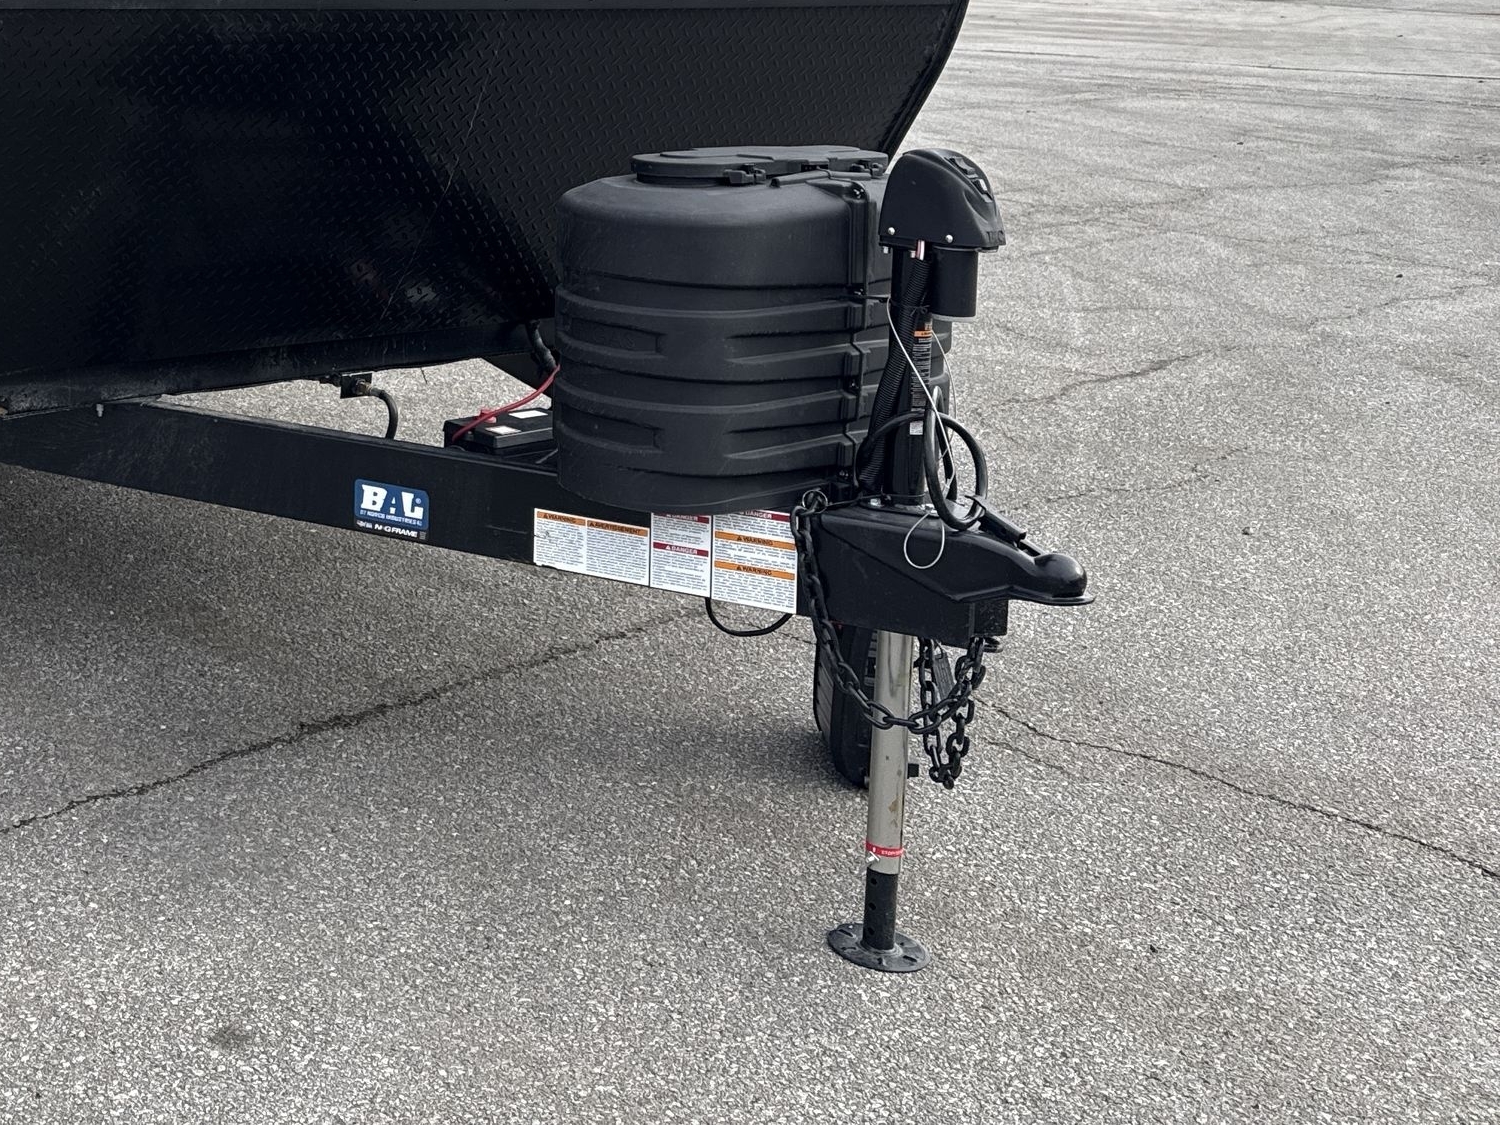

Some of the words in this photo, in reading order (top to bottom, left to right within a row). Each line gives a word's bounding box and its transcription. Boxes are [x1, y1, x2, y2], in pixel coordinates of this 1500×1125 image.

[548, 512, 576, 524] WARNING
[743, 535, 774, 546] WARNING
[672, 546, 698, 555] DANGER
[742, 565, 773, 576] WARNING
